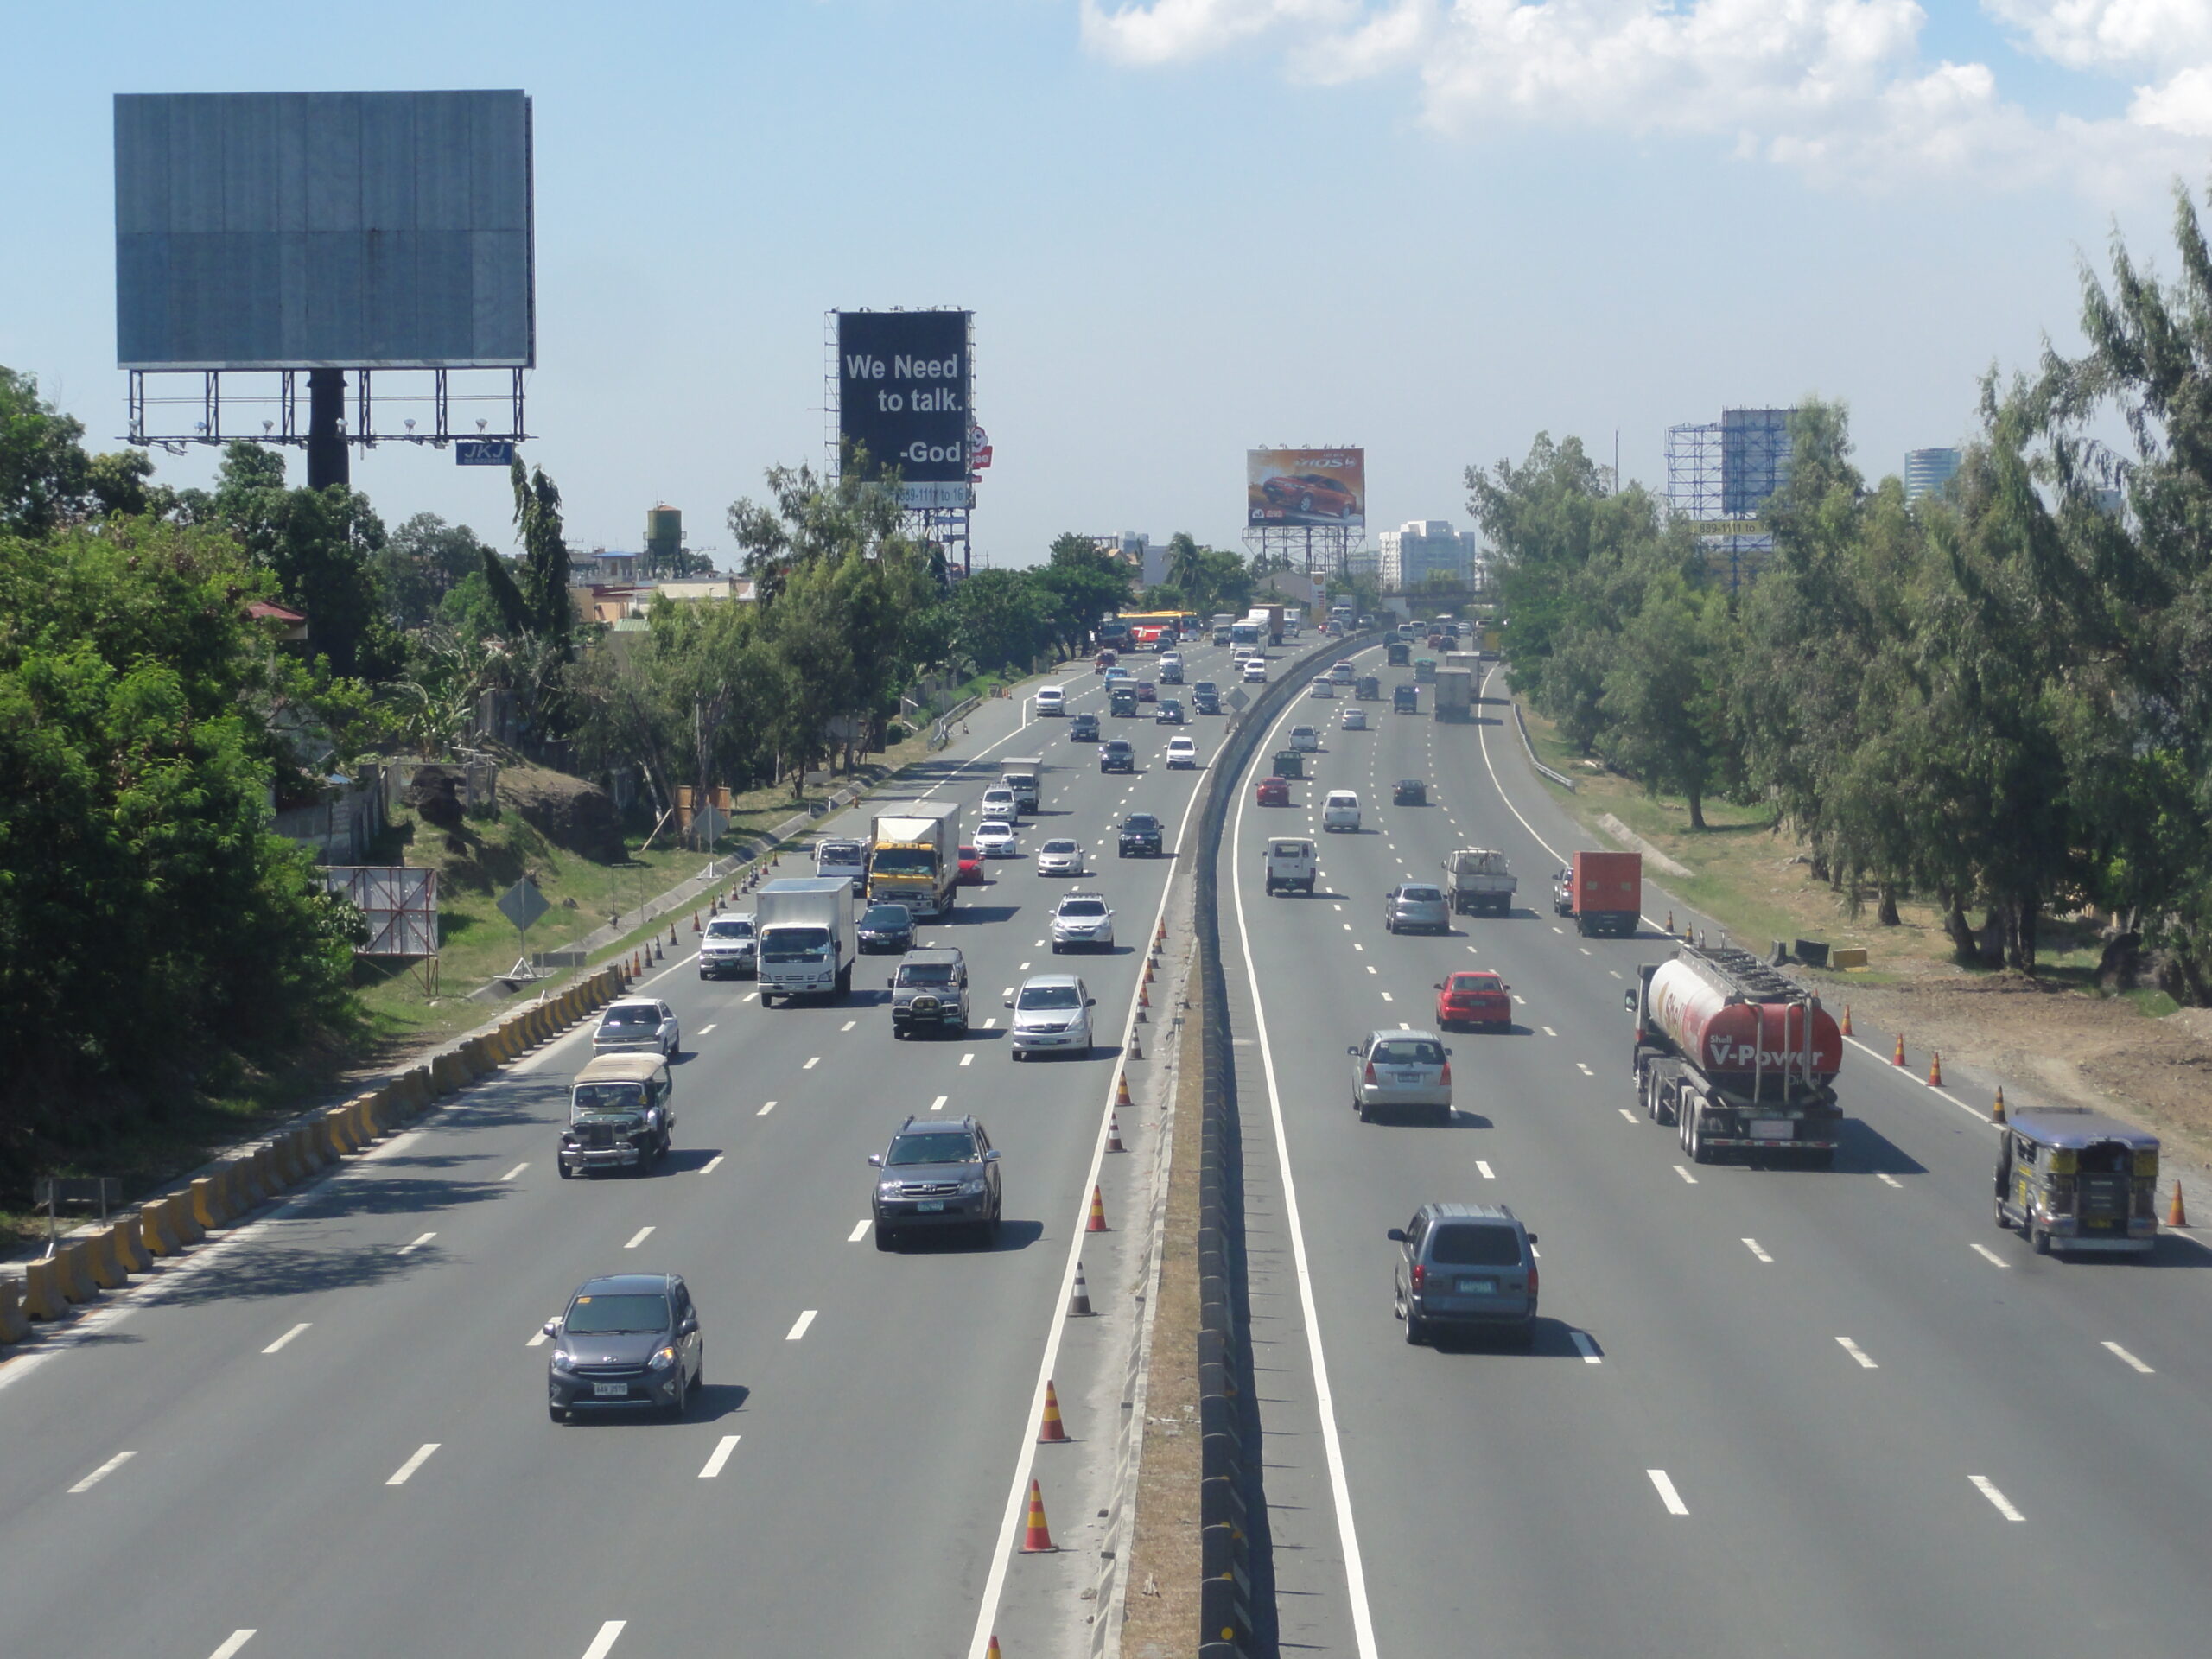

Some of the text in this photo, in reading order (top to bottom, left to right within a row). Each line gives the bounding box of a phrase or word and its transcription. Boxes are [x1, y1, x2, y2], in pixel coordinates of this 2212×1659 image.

[846, 354, 957, 378] We Need
[878, 387, 963, 412] to talk.
[464, 444, 505, 457] JKJ
[899, 441, 961, 462] -God
[941, 488, 950, 501] to
[1745, 524, 1756, 533] to
[1710, 1035, 1732, 1044] Shell
